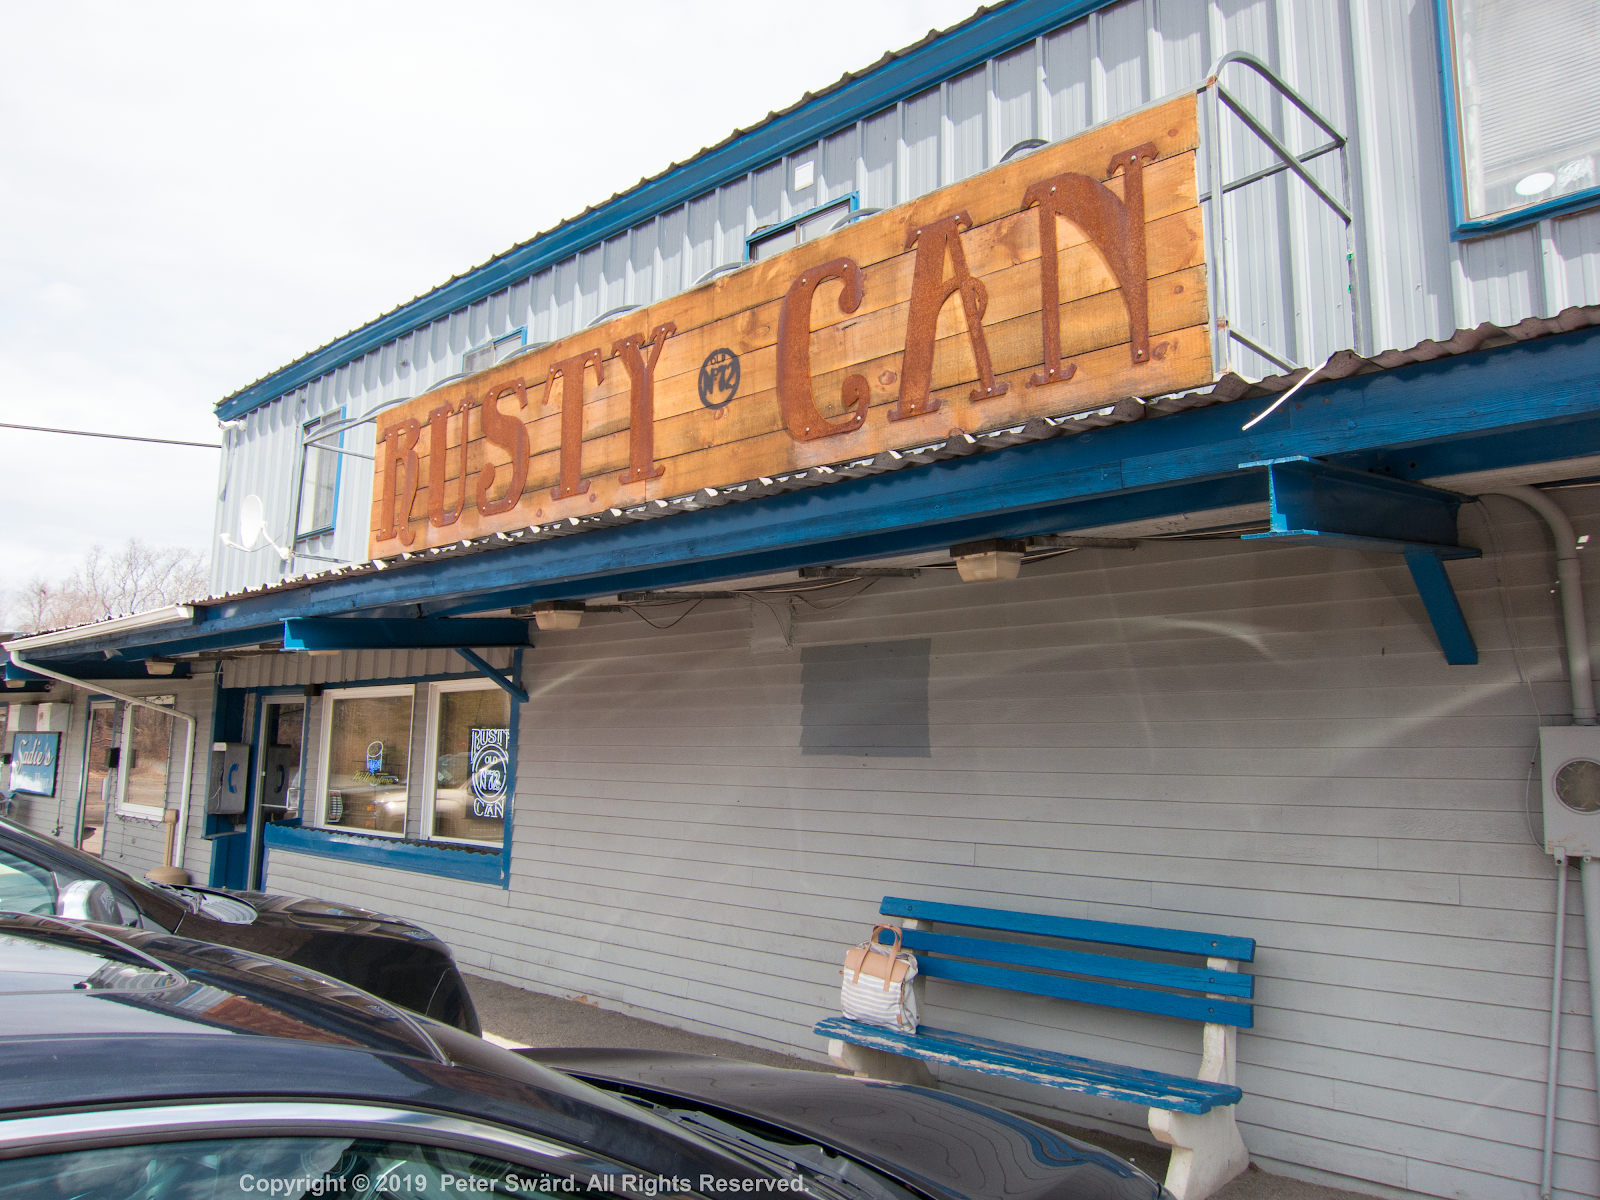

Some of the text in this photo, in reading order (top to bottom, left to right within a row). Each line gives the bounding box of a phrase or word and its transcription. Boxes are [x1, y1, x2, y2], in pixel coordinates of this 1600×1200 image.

[375, 141, 1158, 546] RUSTY CAN
[710, 353, 726, 365] OLD
[14, 739, 54, 774] Sadie's
[484, 755, 499, 764] OLD
[473, 797, 505, 819] CAN
